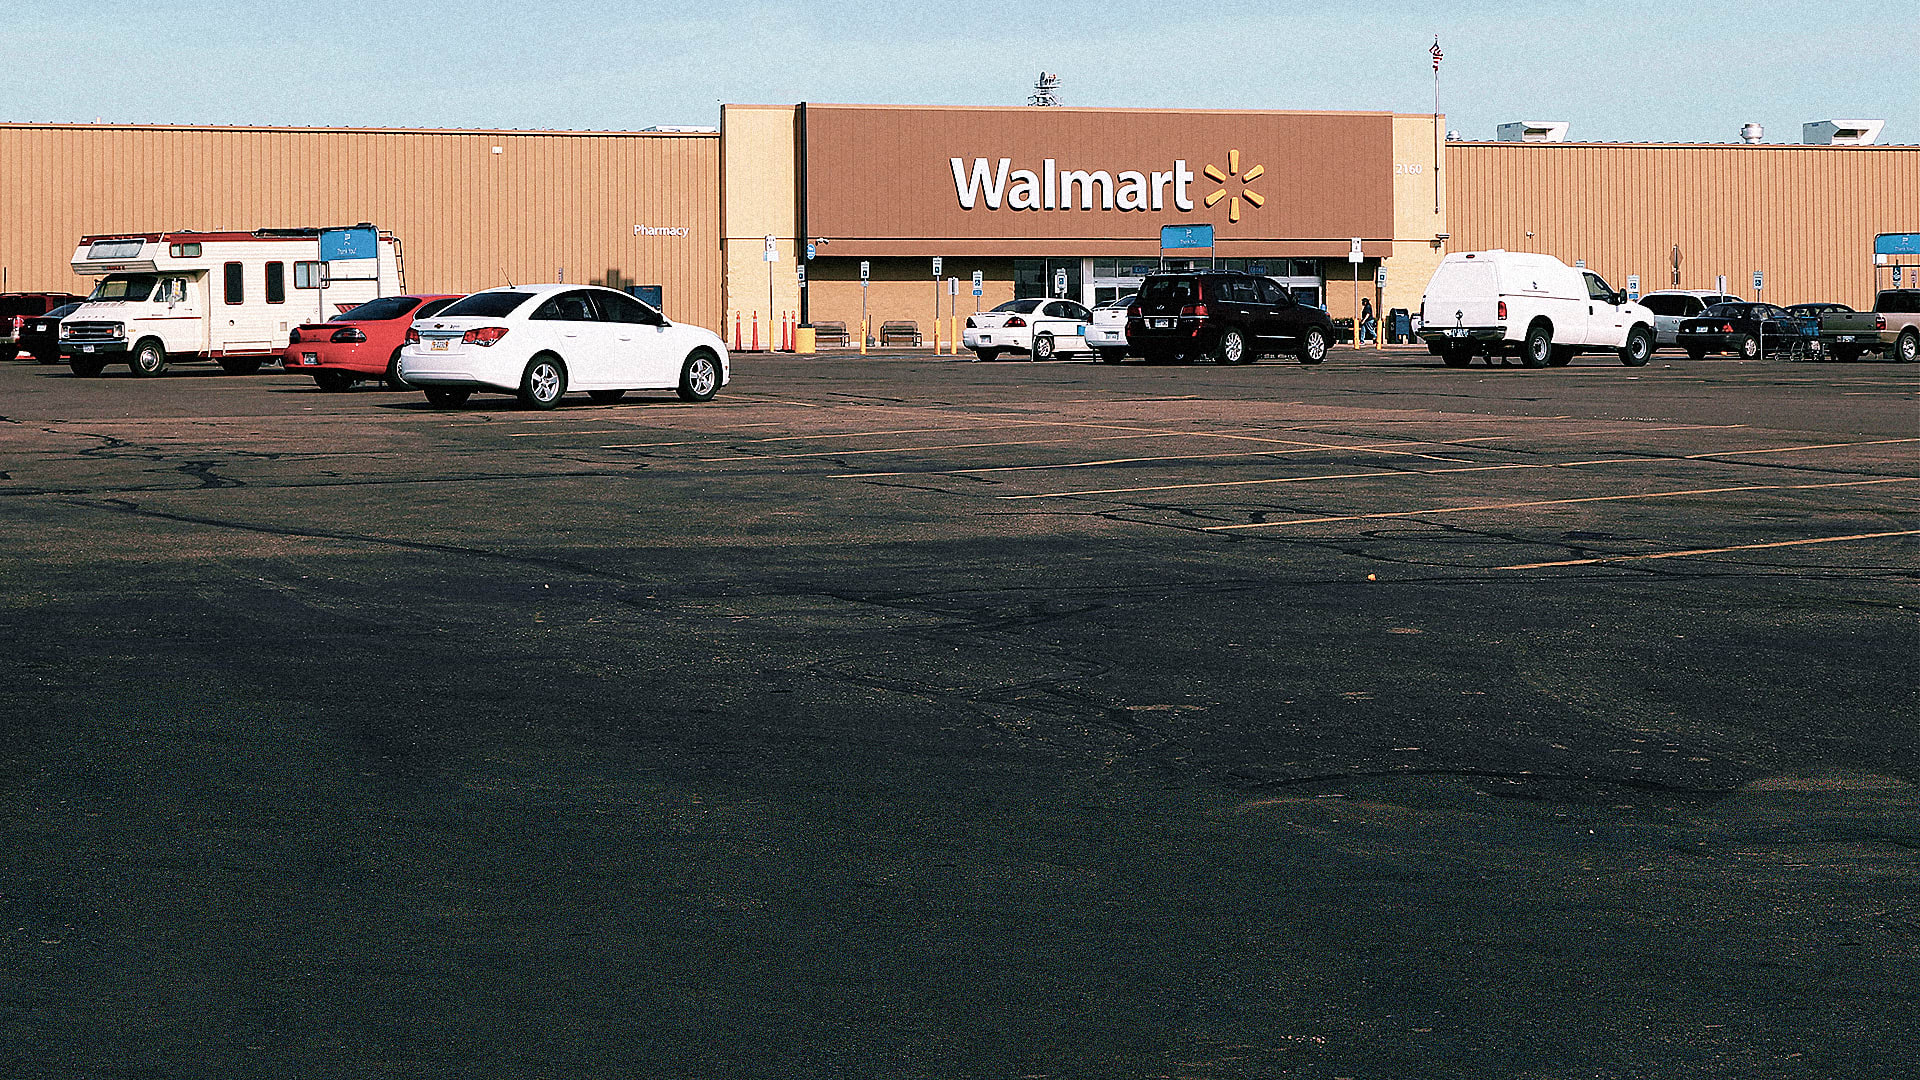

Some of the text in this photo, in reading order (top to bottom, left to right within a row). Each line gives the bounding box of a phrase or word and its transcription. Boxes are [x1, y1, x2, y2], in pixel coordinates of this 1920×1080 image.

[1395, 163, 1423, 175] 2160
[949, 157, 1194, 211] Walmart
[633, 224, 690, 239] Pharmacy
